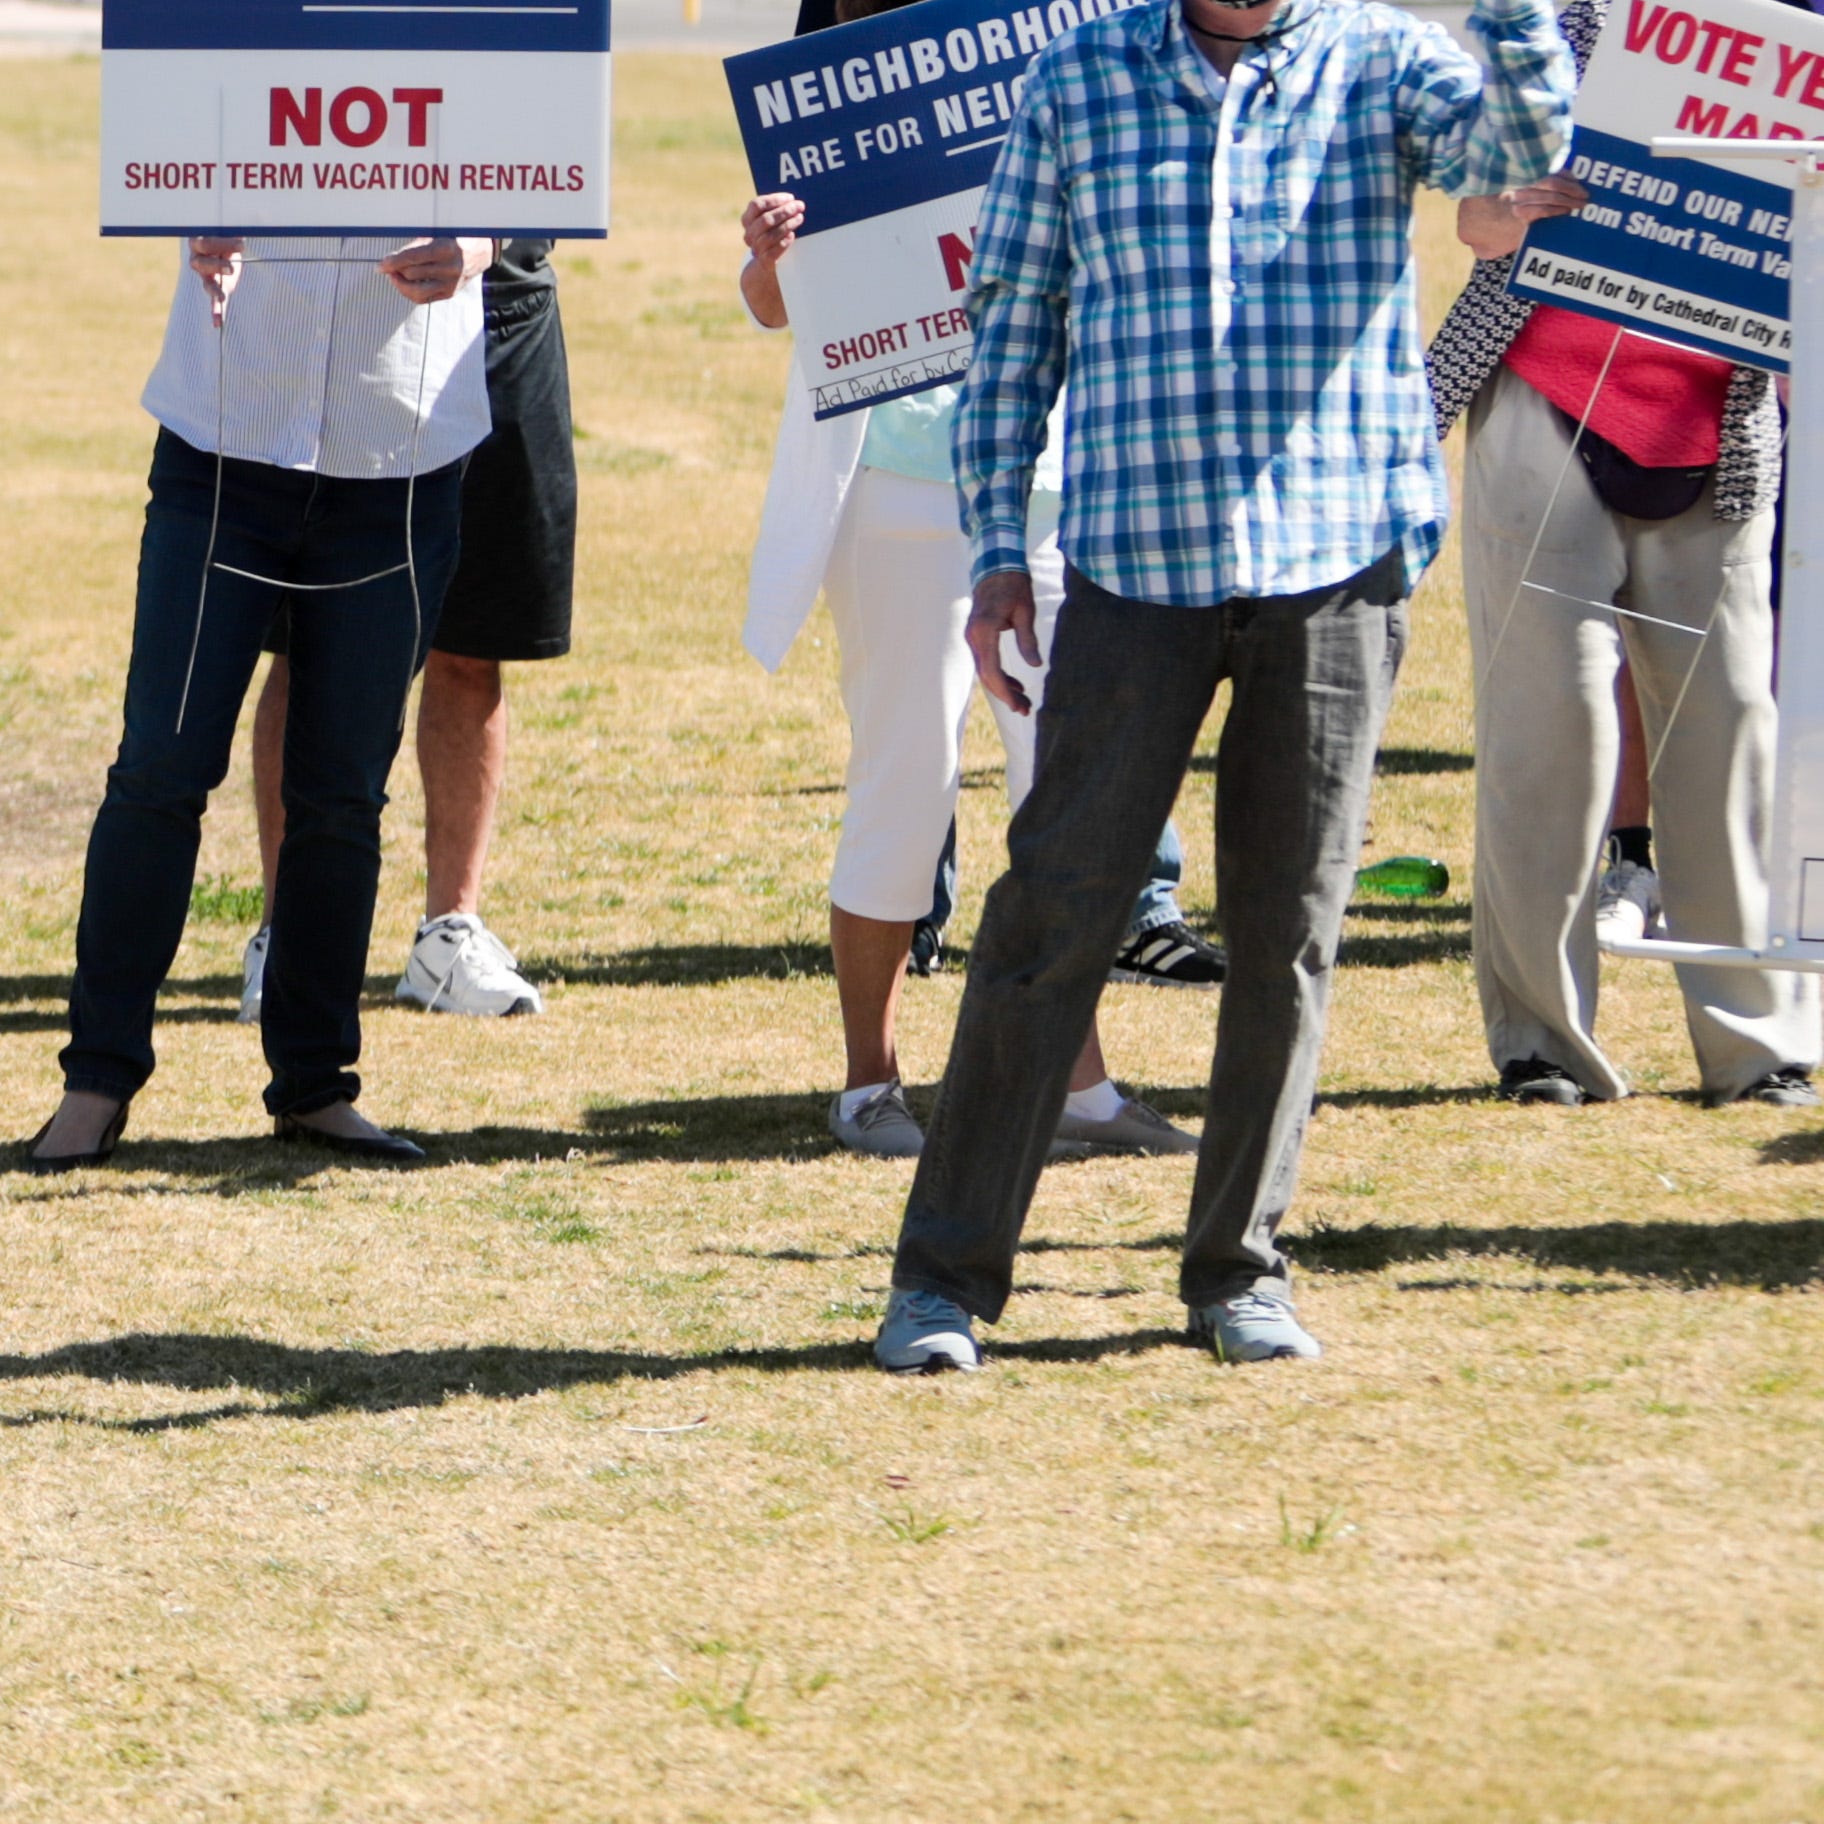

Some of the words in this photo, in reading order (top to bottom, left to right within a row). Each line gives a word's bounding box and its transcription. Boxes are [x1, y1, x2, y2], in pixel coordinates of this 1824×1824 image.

[269, 86, 443, 149] NOT
[125, 162, 217, 190] SHORT
[226, 163, 303, 190] TERM
[313, 163, 449, 191] VACATION
[460, 164, 584, 192] RENTALS
[778, 138, 845, 184] ARE
[855, 117, 923, 162] FOR
[1525, 256, 1549, 279] Ad
[1551, 264, 1592, 291] paid
[1598, 276, 1622, 300] for
[1627, 285, 1650, 310] by
[1653, 291, 1739, 333] Cathedral
[1741, 319, 1778, 348] City
